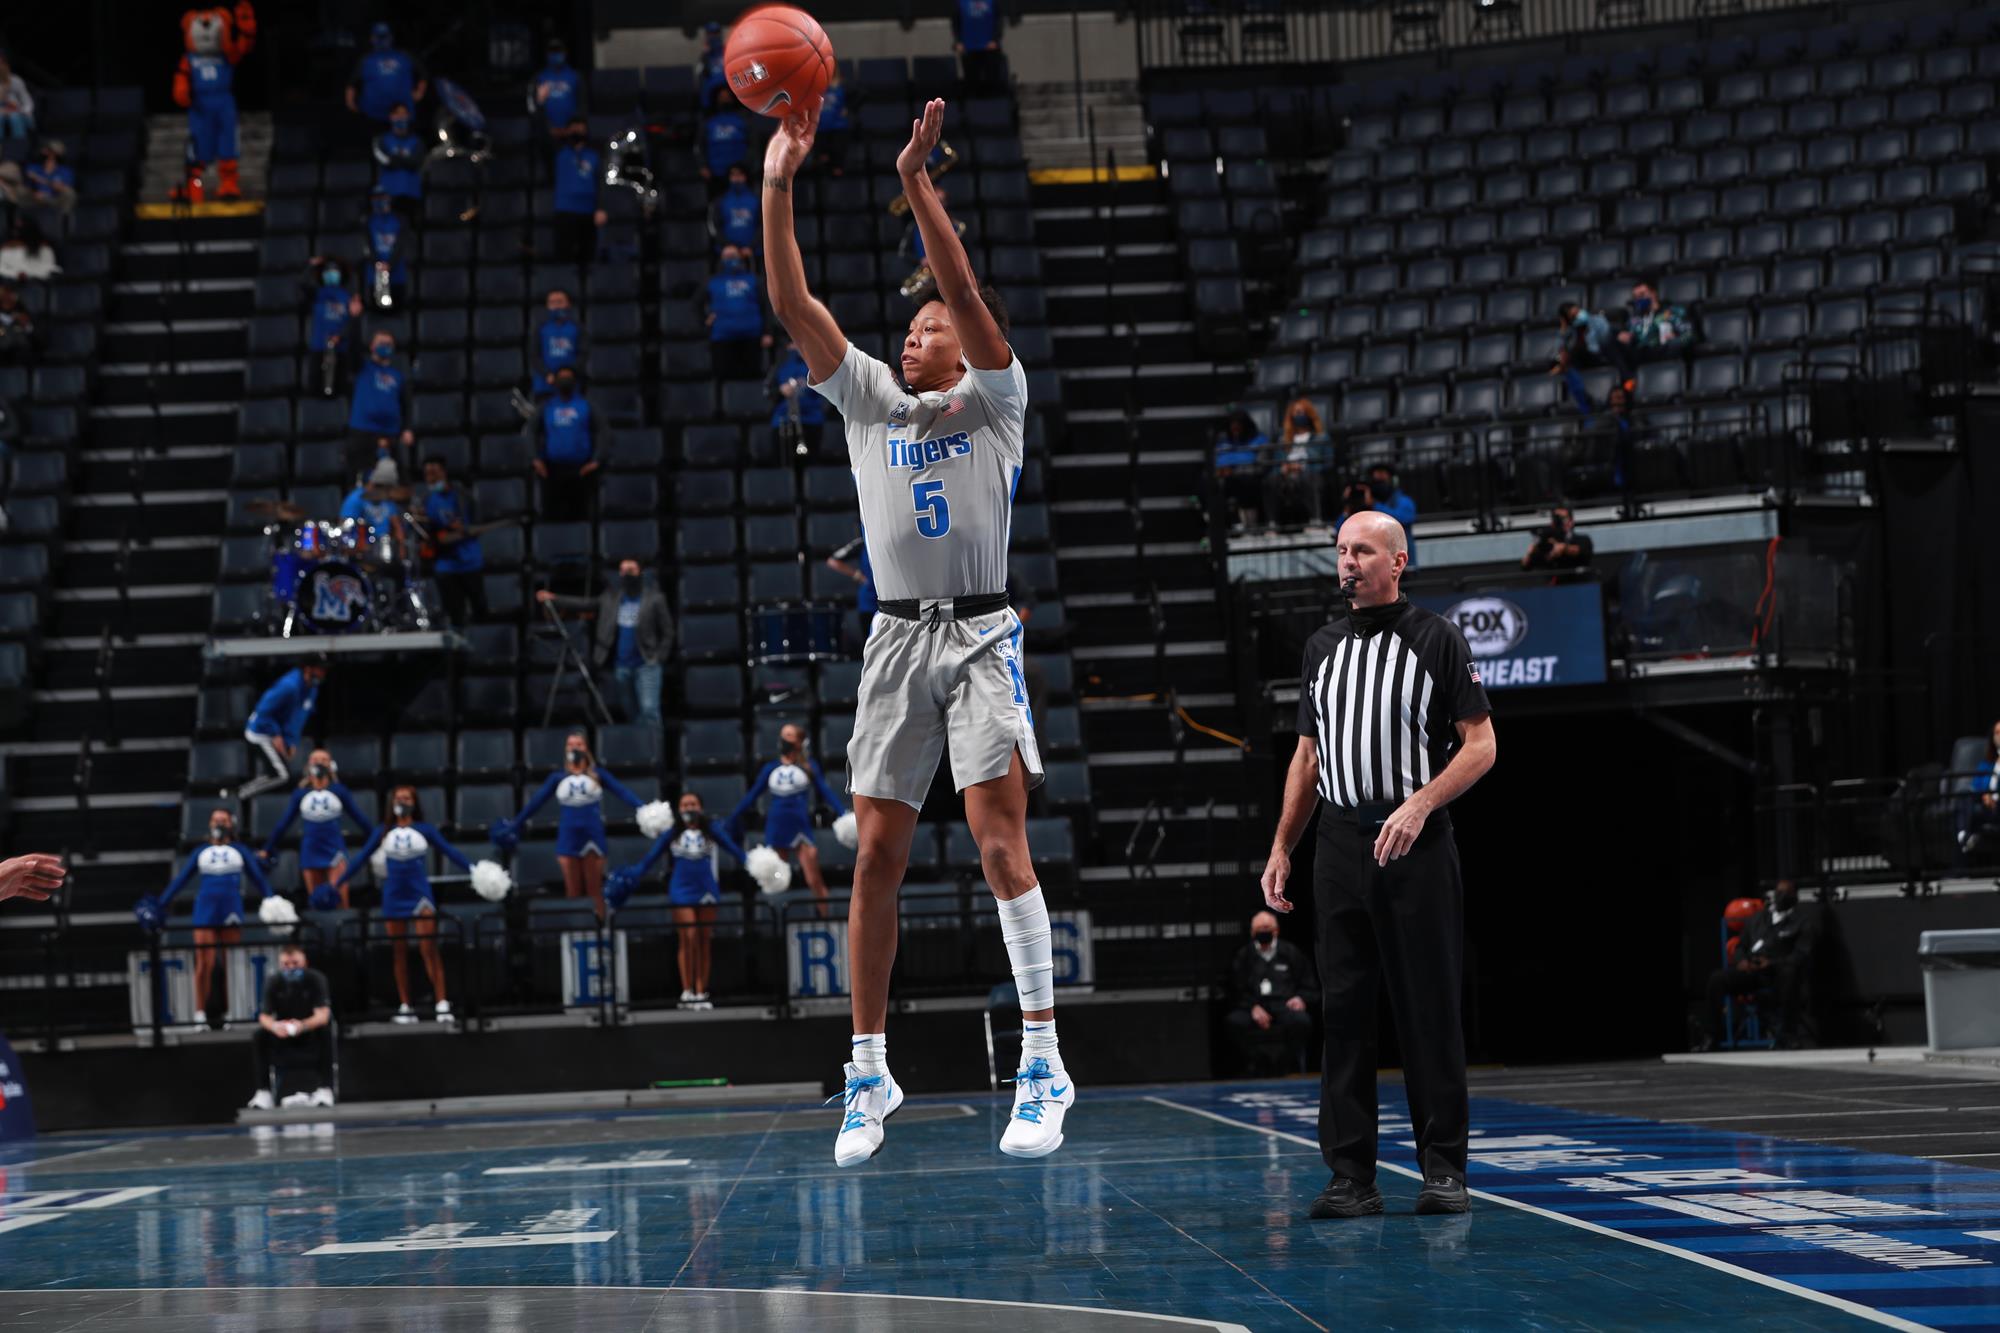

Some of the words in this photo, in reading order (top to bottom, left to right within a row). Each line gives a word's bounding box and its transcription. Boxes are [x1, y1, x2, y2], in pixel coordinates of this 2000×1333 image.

[887, 431, 972, 472] Tigers
[911, 478, 951, 539] 5
[1459, 609, 1505, 632] FOX
[1466, 633, 1508, 643] PORTS
[796, 930, 845, 995] R
